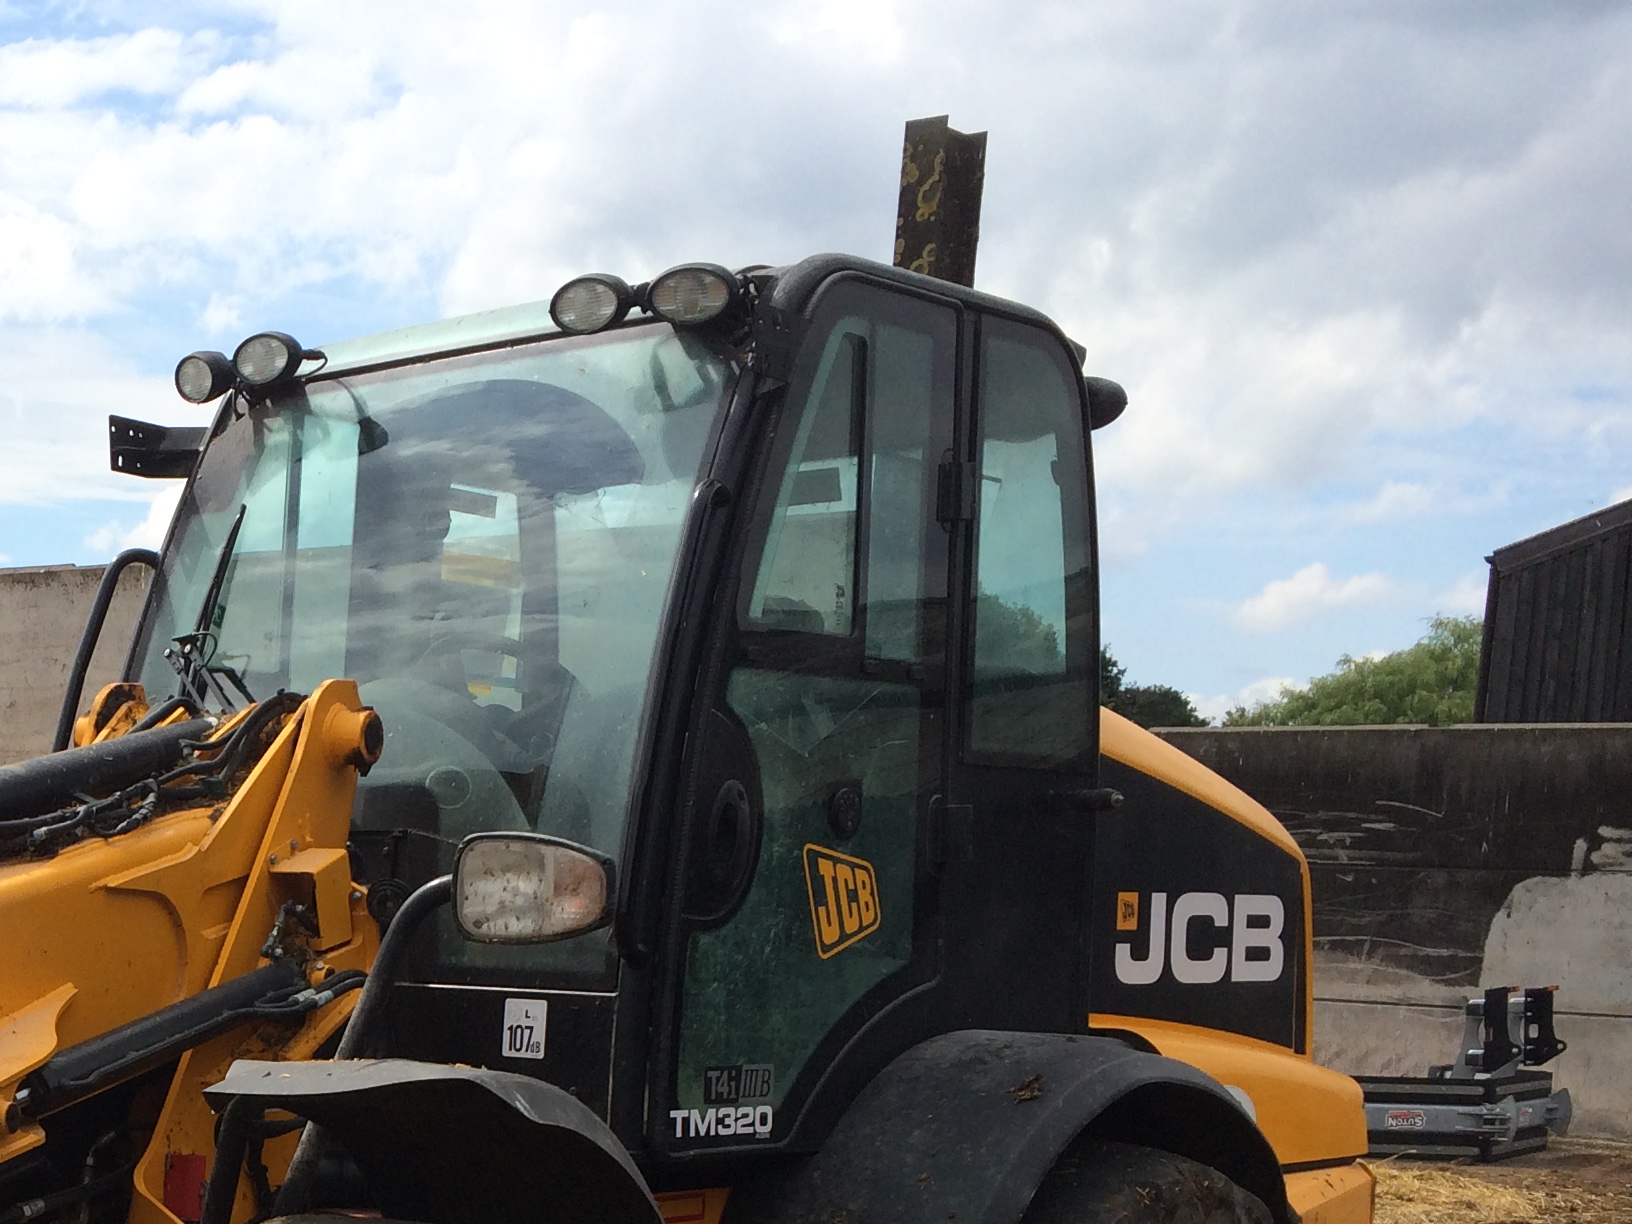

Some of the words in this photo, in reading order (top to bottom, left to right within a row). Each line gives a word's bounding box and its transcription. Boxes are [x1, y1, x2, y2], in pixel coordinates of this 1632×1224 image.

[818, 857, 875, 946] JCB
[1115, 892, 1285, 984] JCB
[507, 1024, 534, 1053] 107
[669, 1105, 773, 1138] TM320
